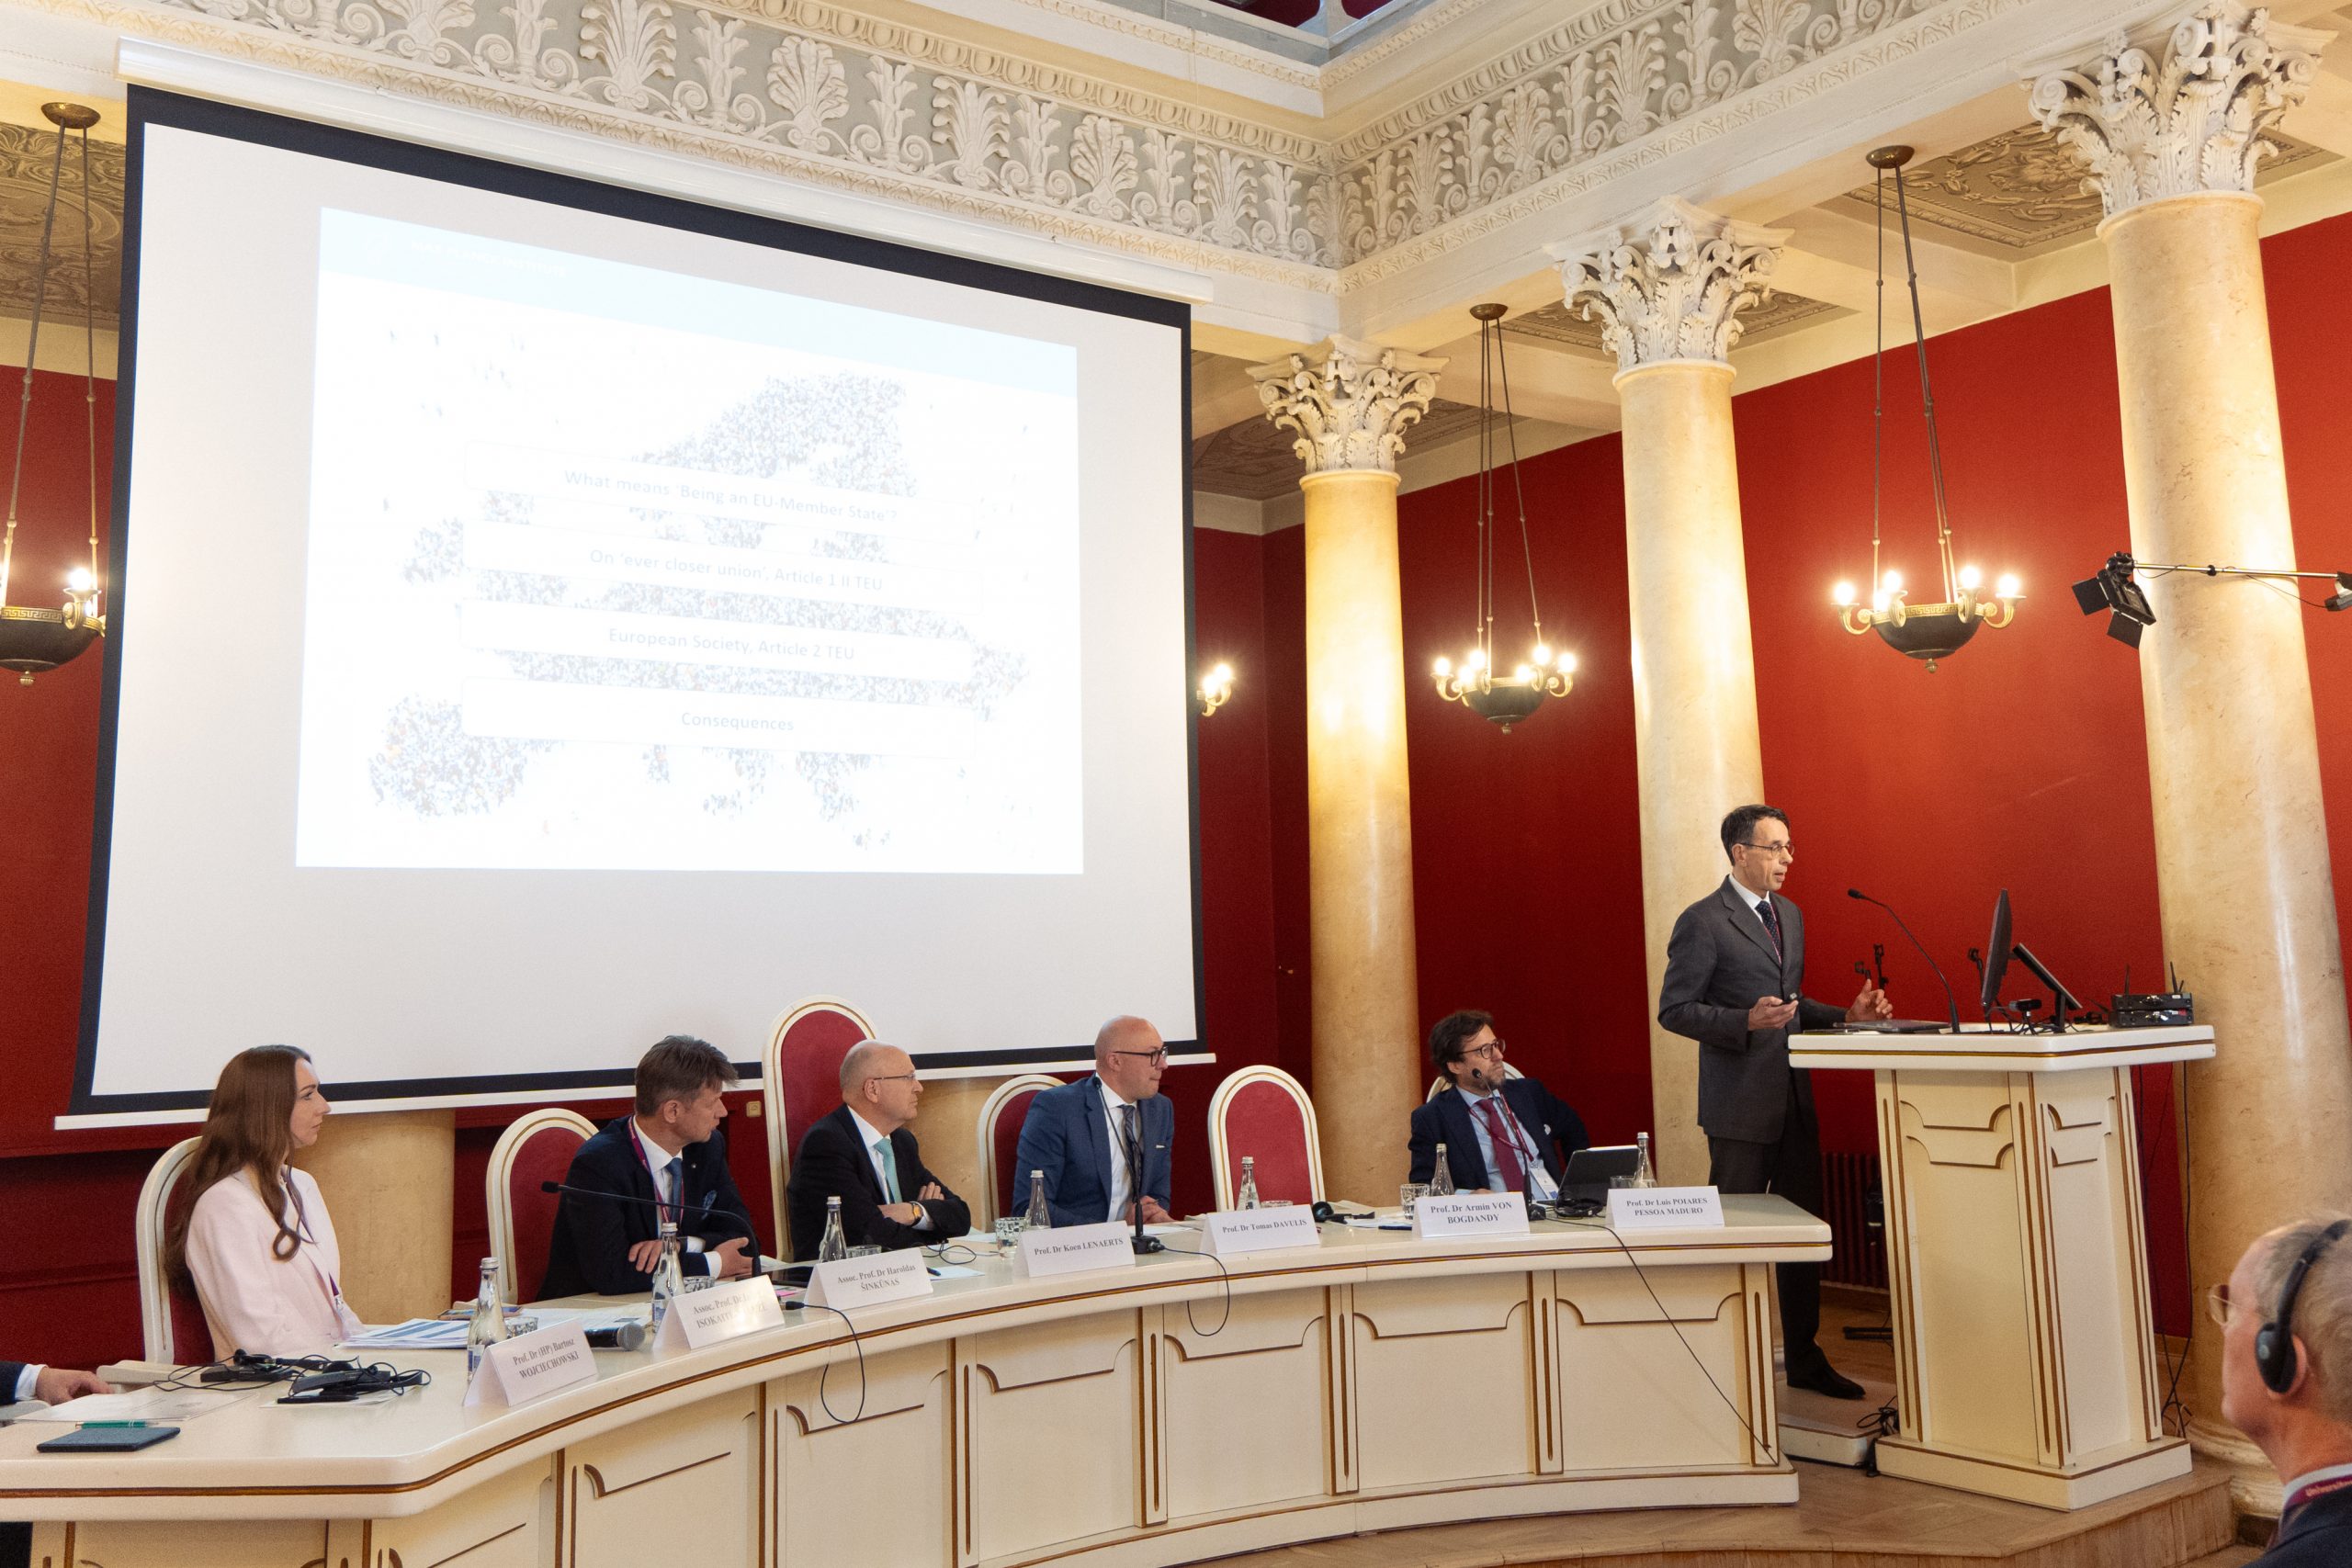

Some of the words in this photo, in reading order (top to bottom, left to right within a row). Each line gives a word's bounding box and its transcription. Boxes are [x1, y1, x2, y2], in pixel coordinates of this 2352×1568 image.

[564, 469, 610, 489] What
[616, 480, 670, 496] means
[729, 492, 748, 506] an
[752, 493, 843, 517] EU-Member
[590, 548, 614, 565] On
[665, 555, 713, 574] closer
[775, 569, 823, 587] Article
[829, 573, 837, 587] 1
[855, 577, 884, 592] TEU
[609, 627, 687, 648] European
[693, 635, 753, 655] Society,
[758, 640, 808, 656] Article
[813, 645, 822, 658] 2
[827, 646, 855, 660] TEU
[682, 712, 795, 731] Consequences
[1430, 1203, 1451, 1213] Prof.
[1452, 1202, 1463, 1212] Dr
[1464, 1202, 1490, 1212] Armin
[1491, 1201, 1512, 1211] VON
[1626, 1199, 1644, 1207] Prof.
[1645, 1198, 1656, 1206] Dr
[1656, 1198, 1671, 1206] Luis
[1672, 1197, 1708, 1206] POIARES
[1447, 1213, 1499, 1224] BOGDANDY
[1634, 1208, 1667, 1217] PESSOA
[1668, 1207, 1703, 1216] MADURO
[1222, 1225, 1240, 1234] Prof.
[1240, 1224, 1250, 1232] Dr
[1250, 1223, 1273, 1231] Tomas
[1273, 1220, 1307, 1229] DAVULIS
[1034, 1244, 1051, 1256] Prof.
[1052, 1243, 1062, 1253] Dr
[1063, 1241, 1081, 1252] Koen
[1082, 1237, 1124, 1250] LENAERTS
[858, 1271, 876, 1280] Prof.
[887, 1265, 916, 1275] Haroldas
[513, 1353, 530, 1366] Prof.
[529, 1349, 538, 1360] Dr
[538, 1344, 554, 1358] (HP)
[552, 1338, 575, 1352] Bartosz
[519, 1350, 580, 1379] WOJCIECHOWSKI
